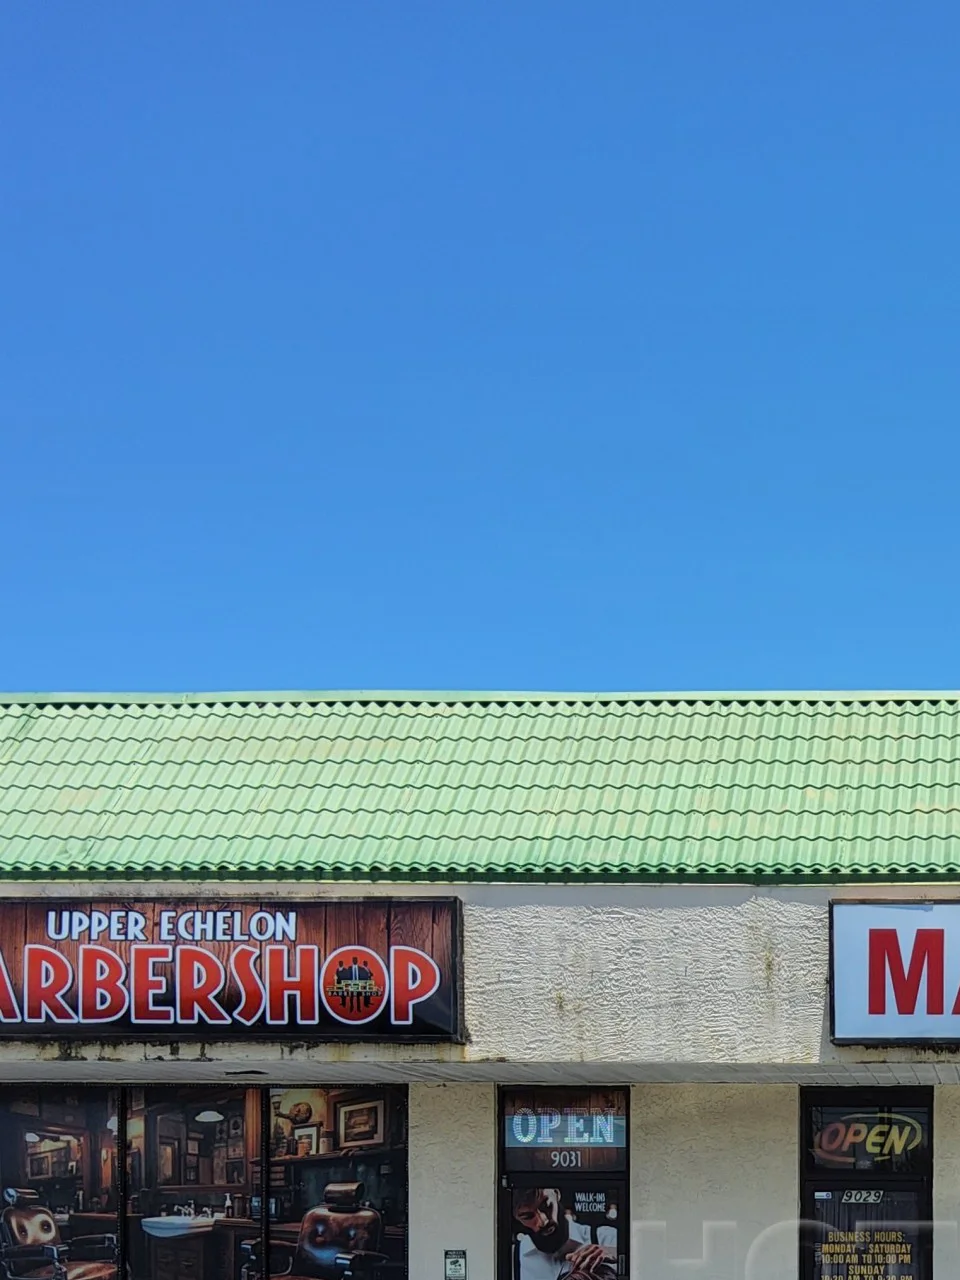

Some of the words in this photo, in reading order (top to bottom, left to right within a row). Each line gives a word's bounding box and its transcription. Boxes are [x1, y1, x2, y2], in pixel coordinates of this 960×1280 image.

[47, 910, 147, 941] UPPER
[160, 910, 297, 941] ECHELON
[512, 1107, 617, 1143] OPEN
[820, 1122, 911, 1155] OPEN
[550, 1151, 581, 1167] 9031
[575, 1192, 606, 1202] WALK-INS
[843, 1190, 882, 1202] 9029
[575, 1202, 606, 1212] WELCOME
[828, 1231, 871, 1242] BUSINESS
[874, 1231, 906, 1242] HOURS:
[821, 1244, 856, 1253] MONDAY
[868, 1244, 912, 1253] SATURDAY
[822, 1254, 844, 1264] 10:00
[845, 1254, 858, 1263] AM
[862, 1254, 872, 1263] TO
[874, 1254, 897, 1264] 10:00
[898, 1254, 911, 1263] PM
[848, 1265, 885, 1275] SUNDAY
